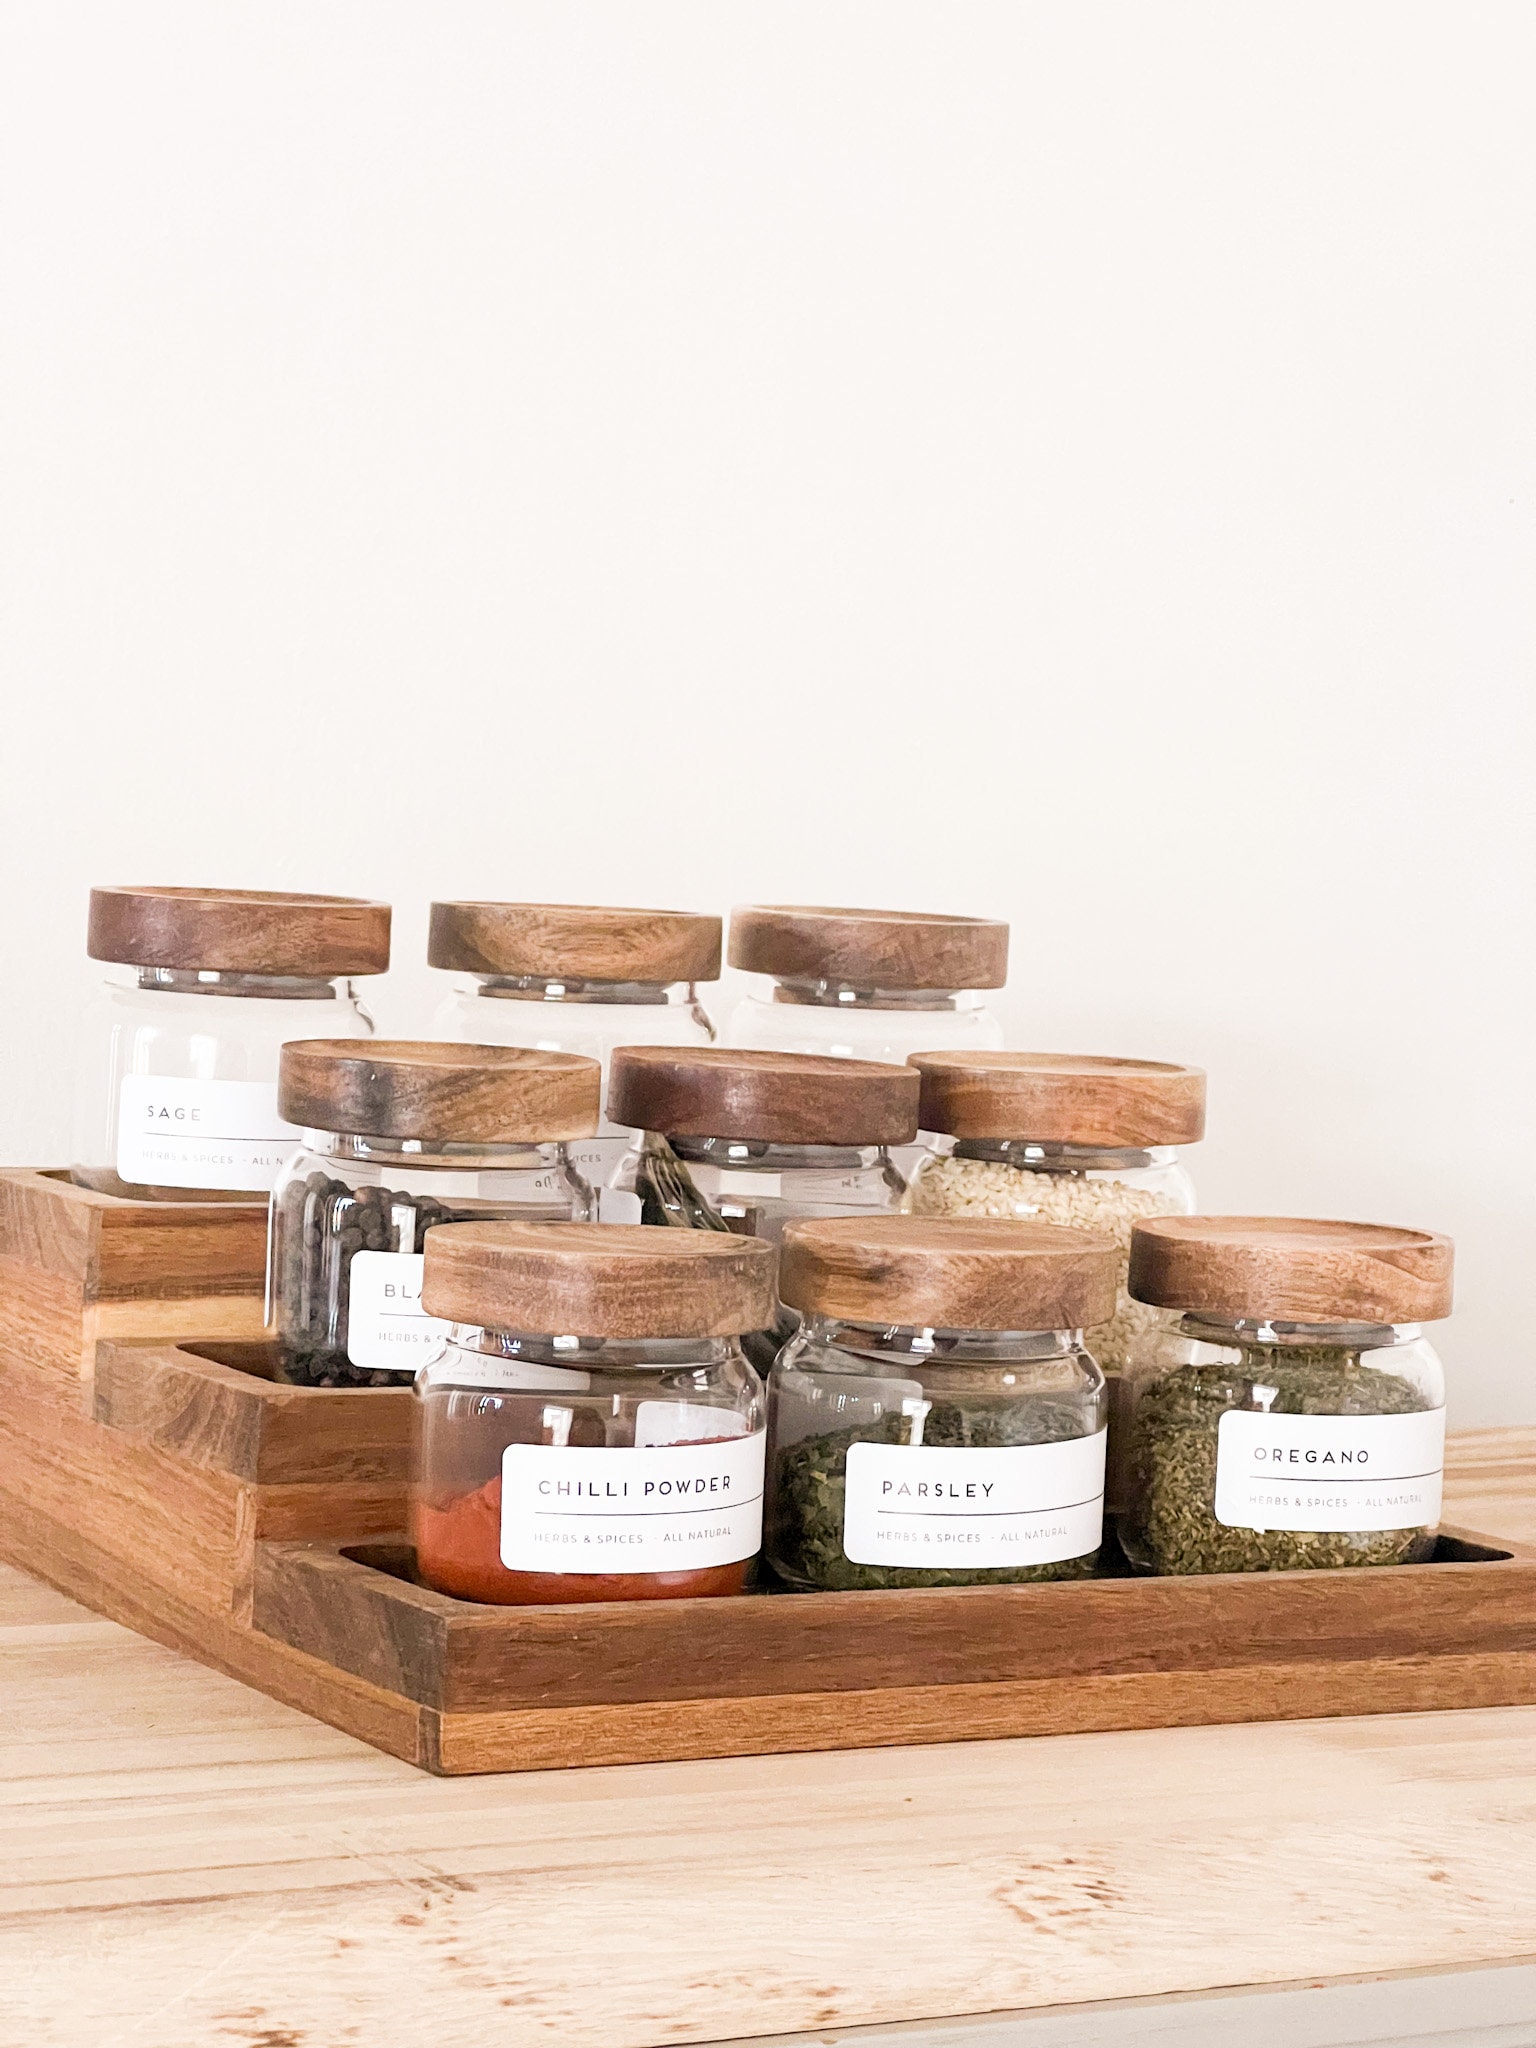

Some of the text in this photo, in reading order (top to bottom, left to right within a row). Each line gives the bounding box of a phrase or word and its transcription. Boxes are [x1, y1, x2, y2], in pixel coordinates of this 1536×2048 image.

[147, 1105, 201, 1121] SAGE
[193, 1154, 233, 1164] SPICES
[252, 1157, 271, 1165] ALL
[576, 1154, 601, 1162] ICES
[1254, 1447, 1369, 1464] OREGANO
[539, 1475, 731, 1496] CHILLI POWDER
[882, 1481, 994, 1497] PARSLEY
[1249, 1496, 1289, 1506] HERBS
[1295, 1497, 1302, 1507] &
[1307, 1498, 1348, 1507] SPICES
[1365, 1498, 1383, 1507] ALL
[1386, 1494, 1423, 1505] NATURAL
[534, 1532, 577, 1543] HERBS
[583, 1534, 591, 1544] &
[597, 1534, 643, 1544] SPICES
[663, 1532, 684, 1542] ALL
[688, 1526, 732, 1541] NATURAL
[877, 1531, 918, 1542] HERBS
[923, 1533, 931, 1542] &
[937, 1533, 981, 1543] SPICES
[1001, 1532, 1020, 1541] ALL
[1024, 1526, 1068, 1540] NATURAL
